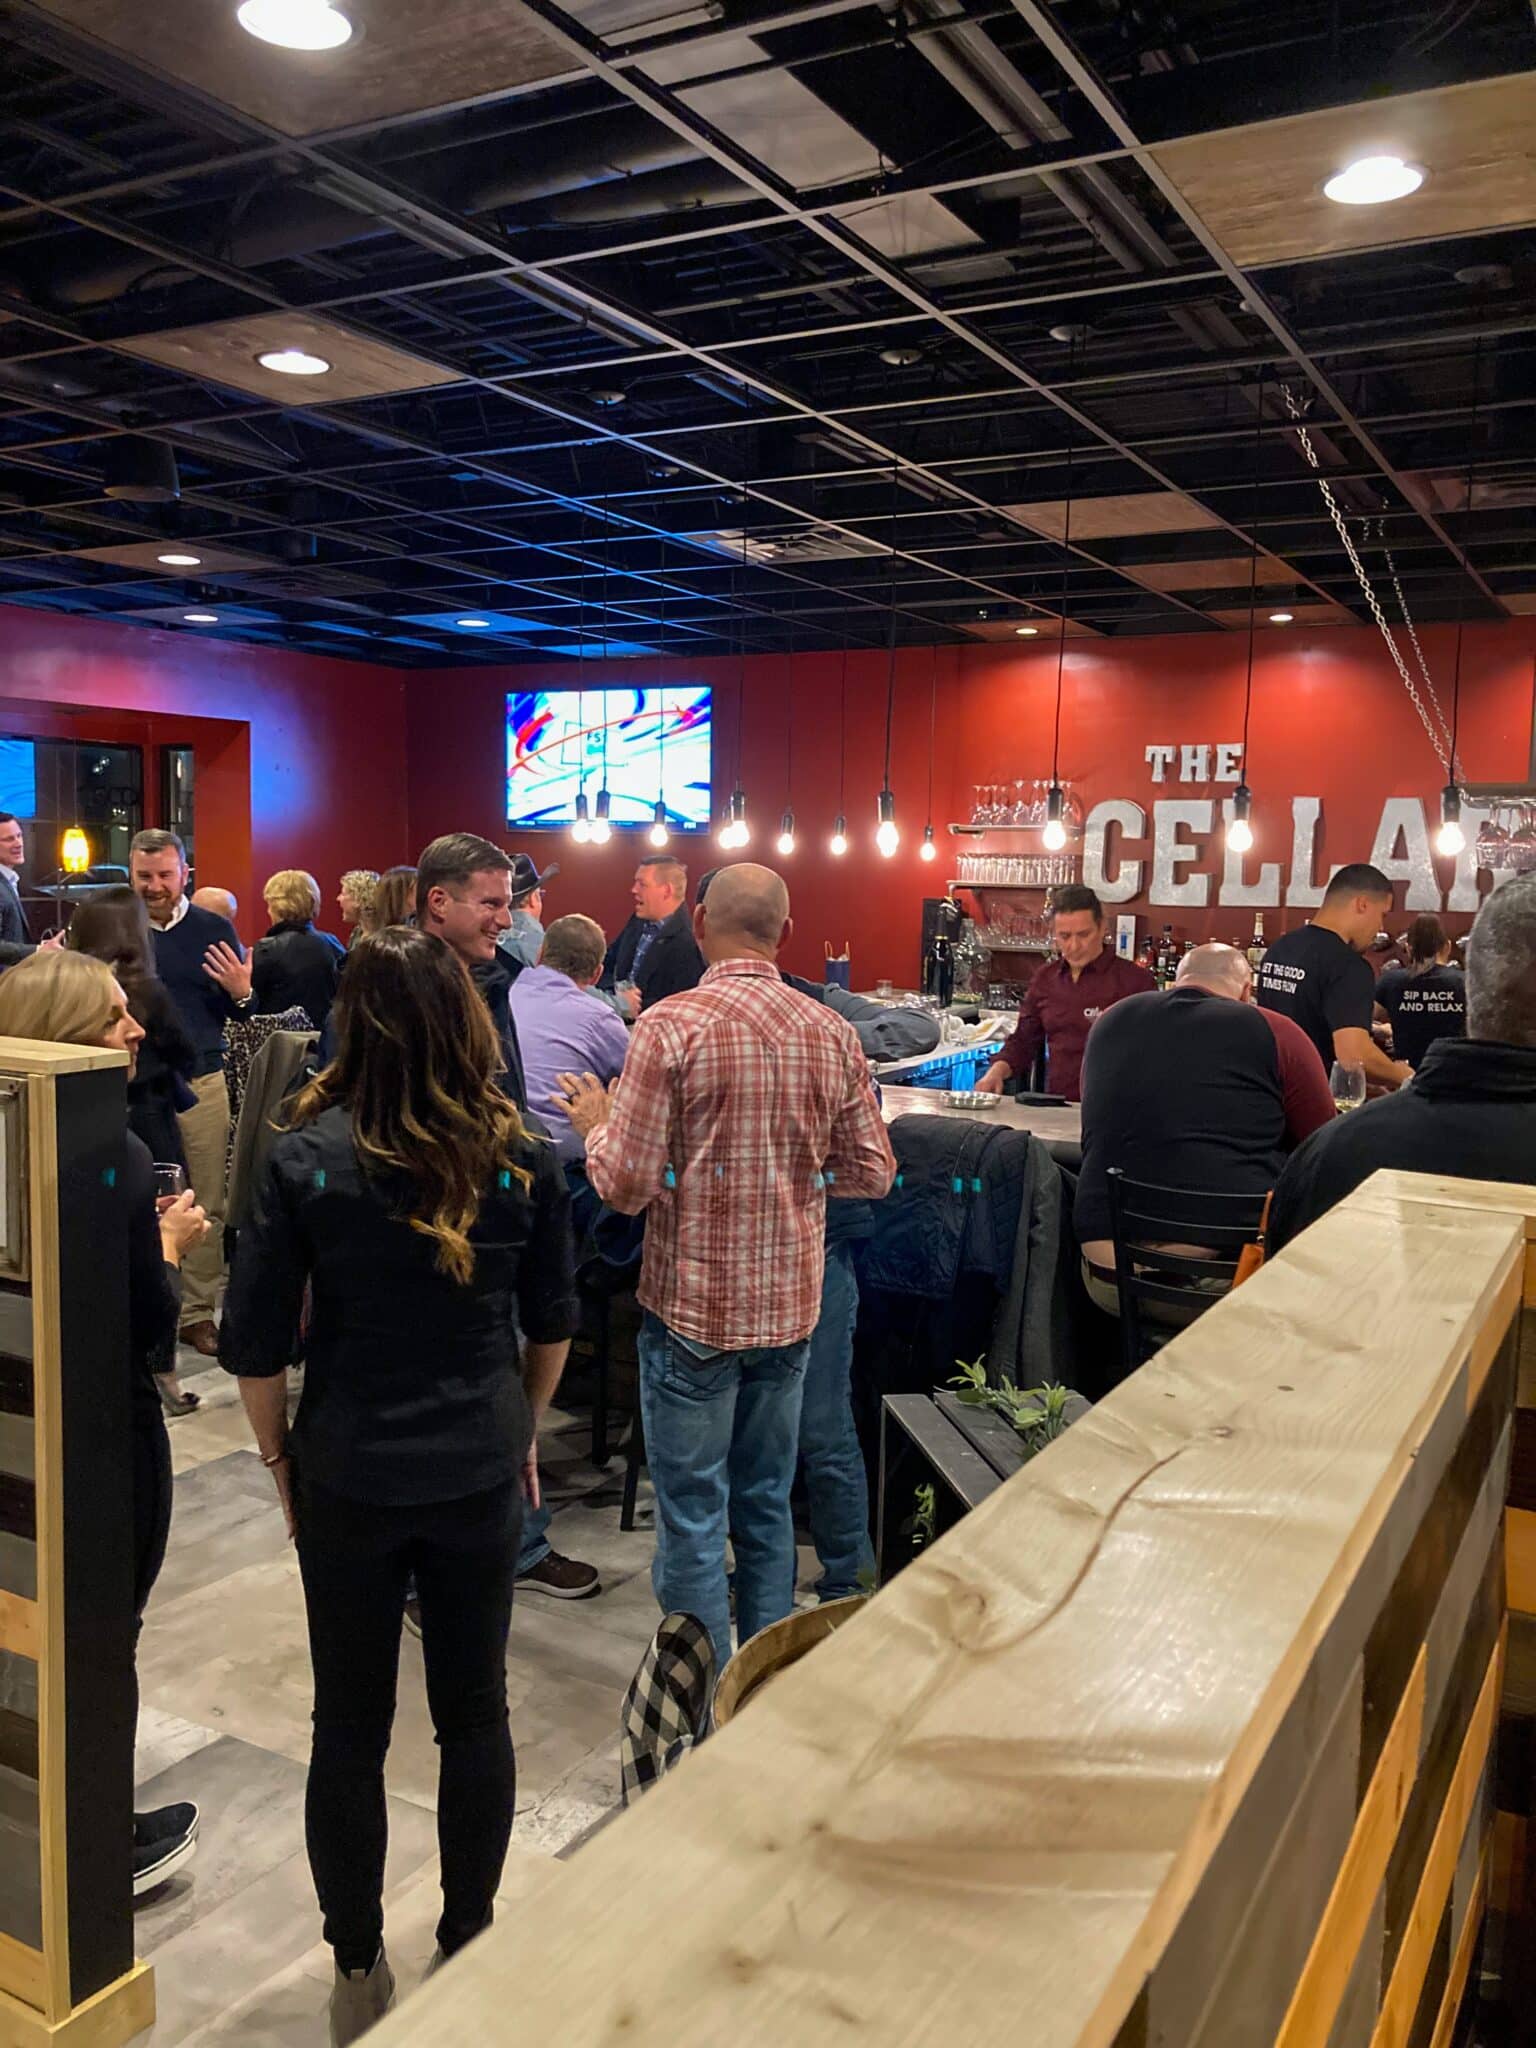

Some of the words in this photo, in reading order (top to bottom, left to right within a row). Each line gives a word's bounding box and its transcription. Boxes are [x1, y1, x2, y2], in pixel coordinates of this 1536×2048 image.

[1144, 743, 1245, 782] THE
[1284, 965, 1306, 980] GOOD
[1403, 990, 1420, 1001] SIP
[1422, 991, 1455, 1001] BACK
[1398, 1002, 1424, 1012] AND
[1427, 1002, 1464, 1013] RELAX
